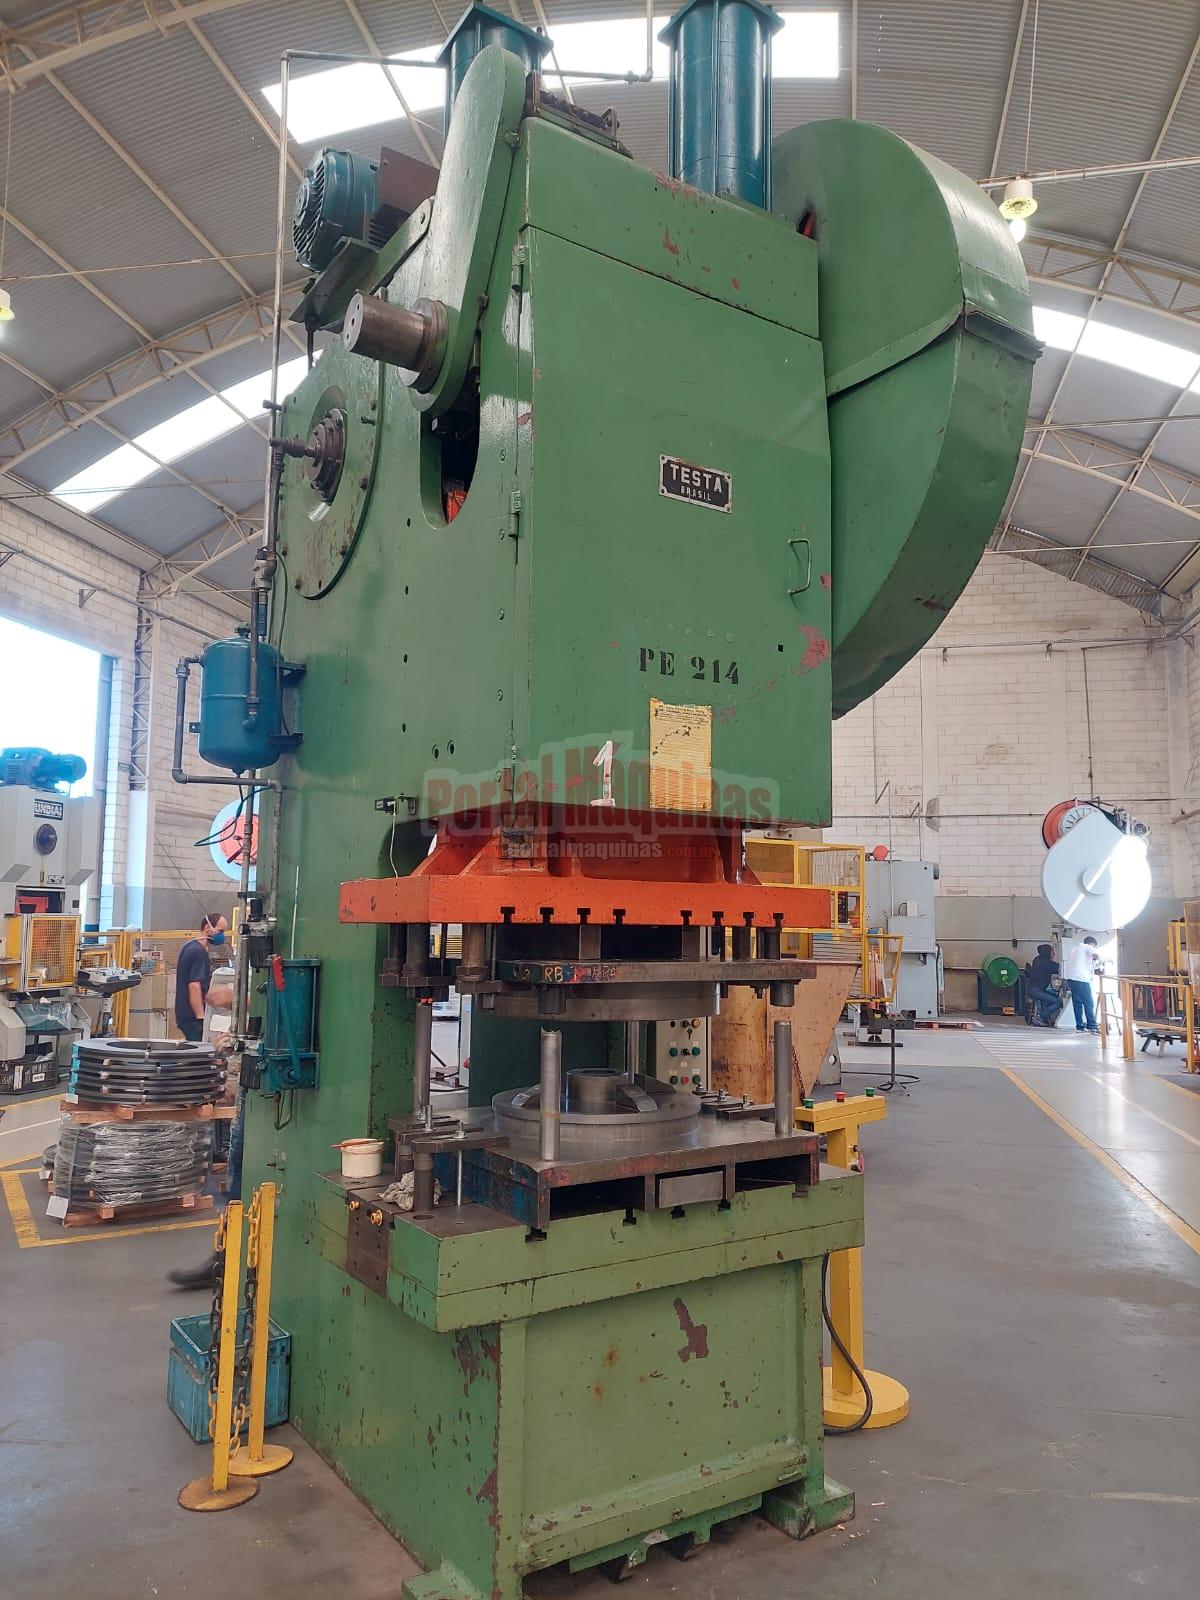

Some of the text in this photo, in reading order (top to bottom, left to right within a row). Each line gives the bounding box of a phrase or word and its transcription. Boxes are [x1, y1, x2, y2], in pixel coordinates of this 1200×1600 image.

[670, 463, 723, 493] TESTA
[680, 485, 711, 501] BRASIL
[640, 647, 739, 685] PE 214
[590, 740, 616, 807] 1
